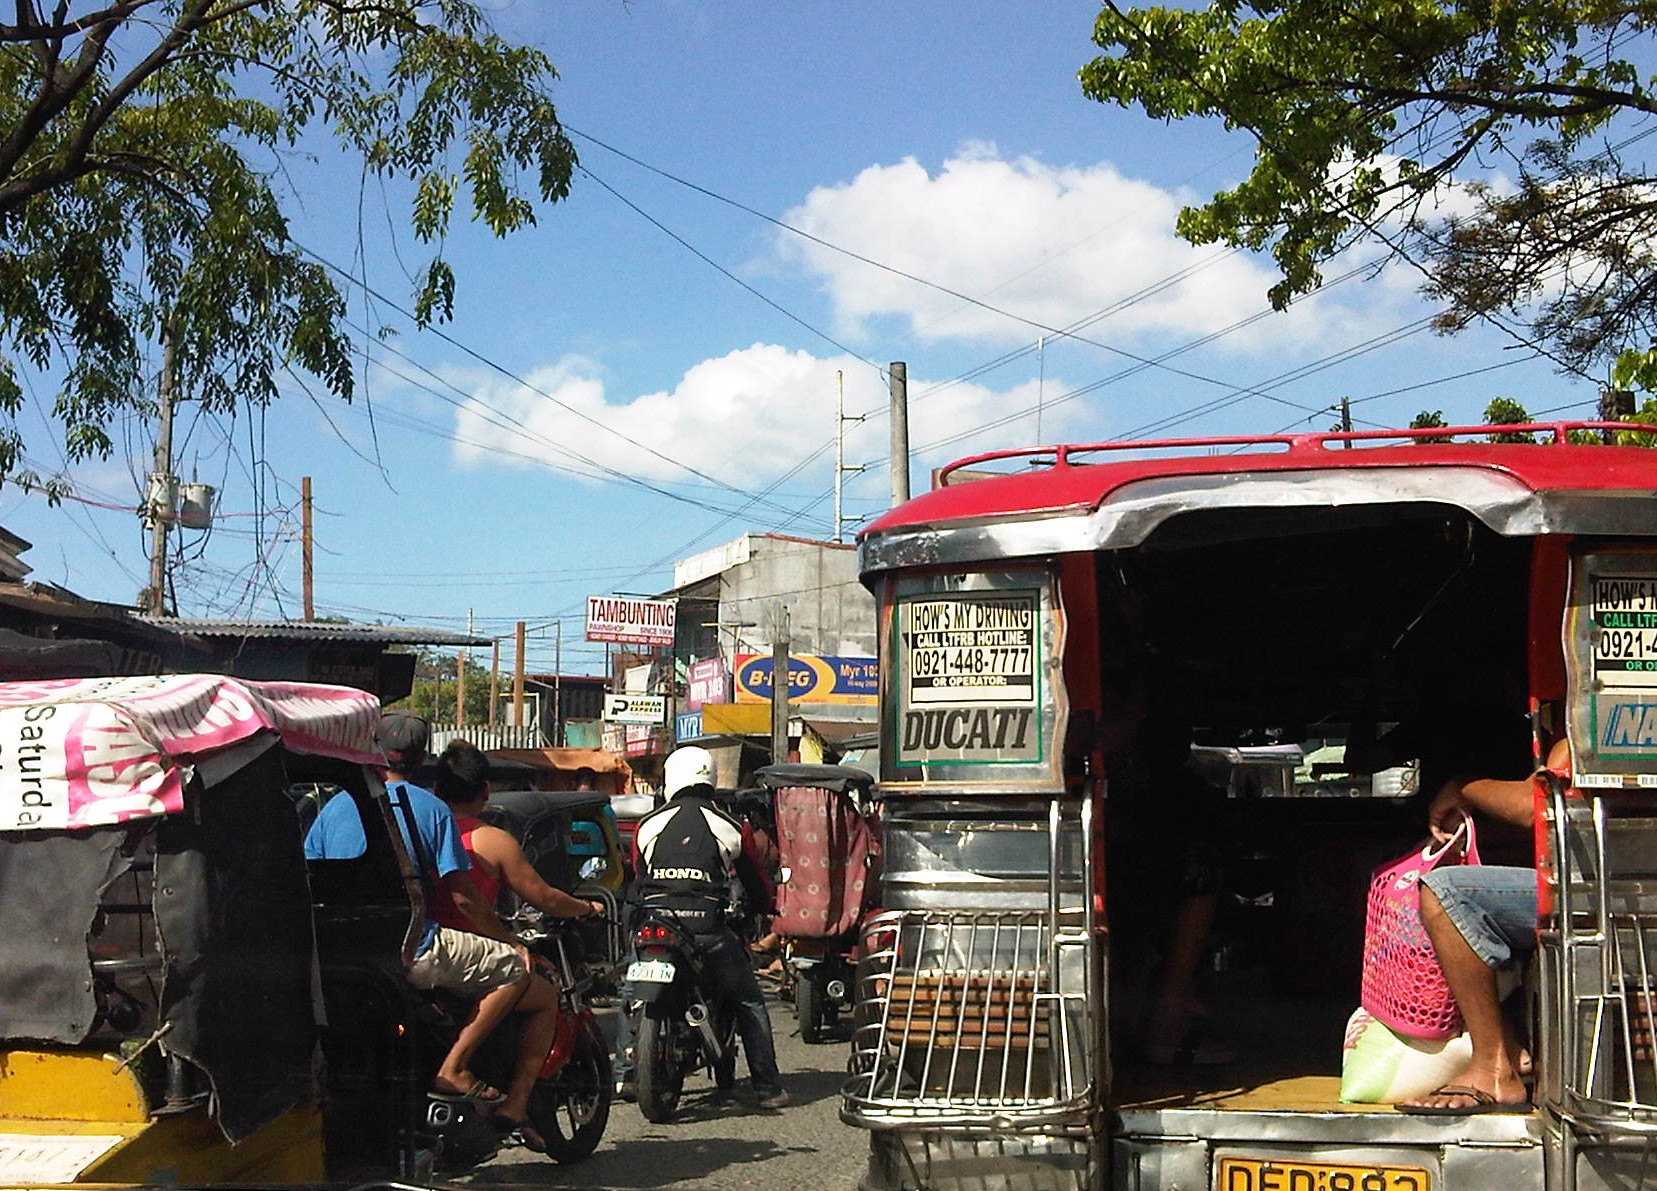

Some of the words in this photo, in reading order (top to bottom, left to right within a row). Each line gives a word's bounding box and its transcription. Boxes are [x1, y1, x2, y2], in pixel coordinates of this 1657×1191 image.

[1599, 582, 1646, 610] HOW'S
[590, 599, 674, 627] TAMBUNTING
[914, 604, 950, 631] HOW'S
[954, 604, 972, 629] MY
[976, 601, 1029, 629] DRIVING
[1604, 613, 1634, 627] CALL
[589, 623, 625, 632] PAWNSHOP
[917, 632, 940, 648] CALL
[942, 631, 975, 647] LTFRB
[977, 631, 1027, 646] HOTLINE:
[915, 648, 1029, 675] 0921-448-7777
[1626, 661, 1642, 670] OR
[748, 670, 811, 687] B-EG
[840, 664, 860, 680] Myr
[932, 677, 947, 687] OR
[949, 676, 1007, 686] OPERATOR:
[903, 708, 1033, 751] DUCATI
[653, 868, 712, 883] HONDA
